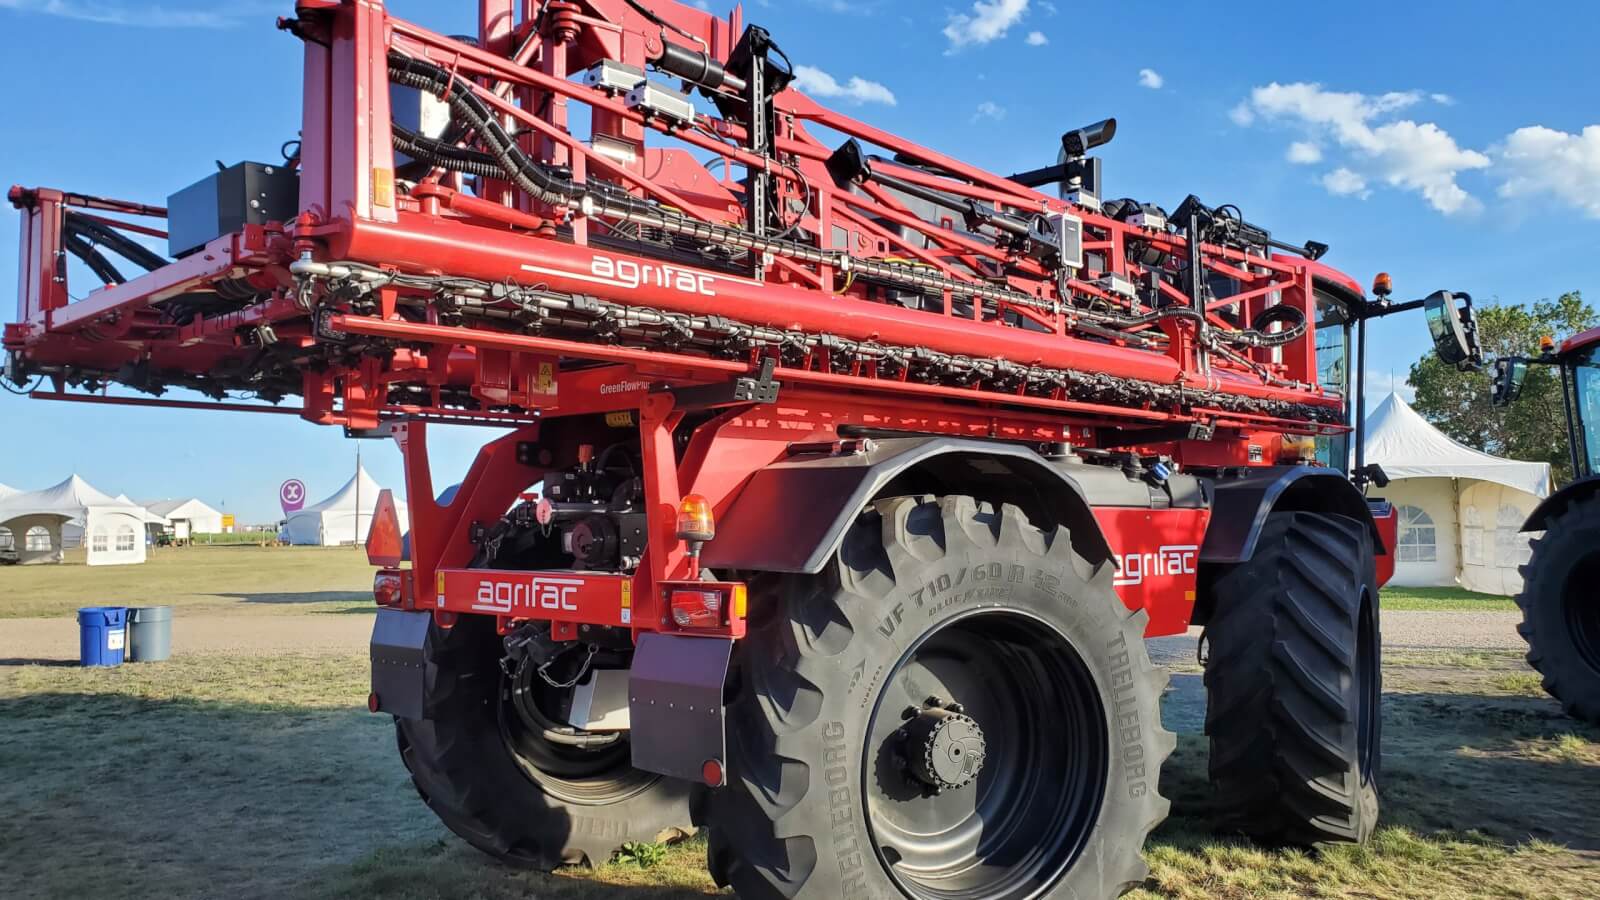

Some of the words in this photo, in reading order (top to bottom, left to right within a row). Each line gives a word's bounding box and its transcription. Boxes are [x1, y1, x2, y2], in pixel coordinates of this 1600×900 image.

[590, 254, 716, 297] agrifac
[471, 576, 585, 613] agrifac
[1106, 630, 1147, 800] TRELLEBORG
[821, 719, 869, 900] RELLEBORG
